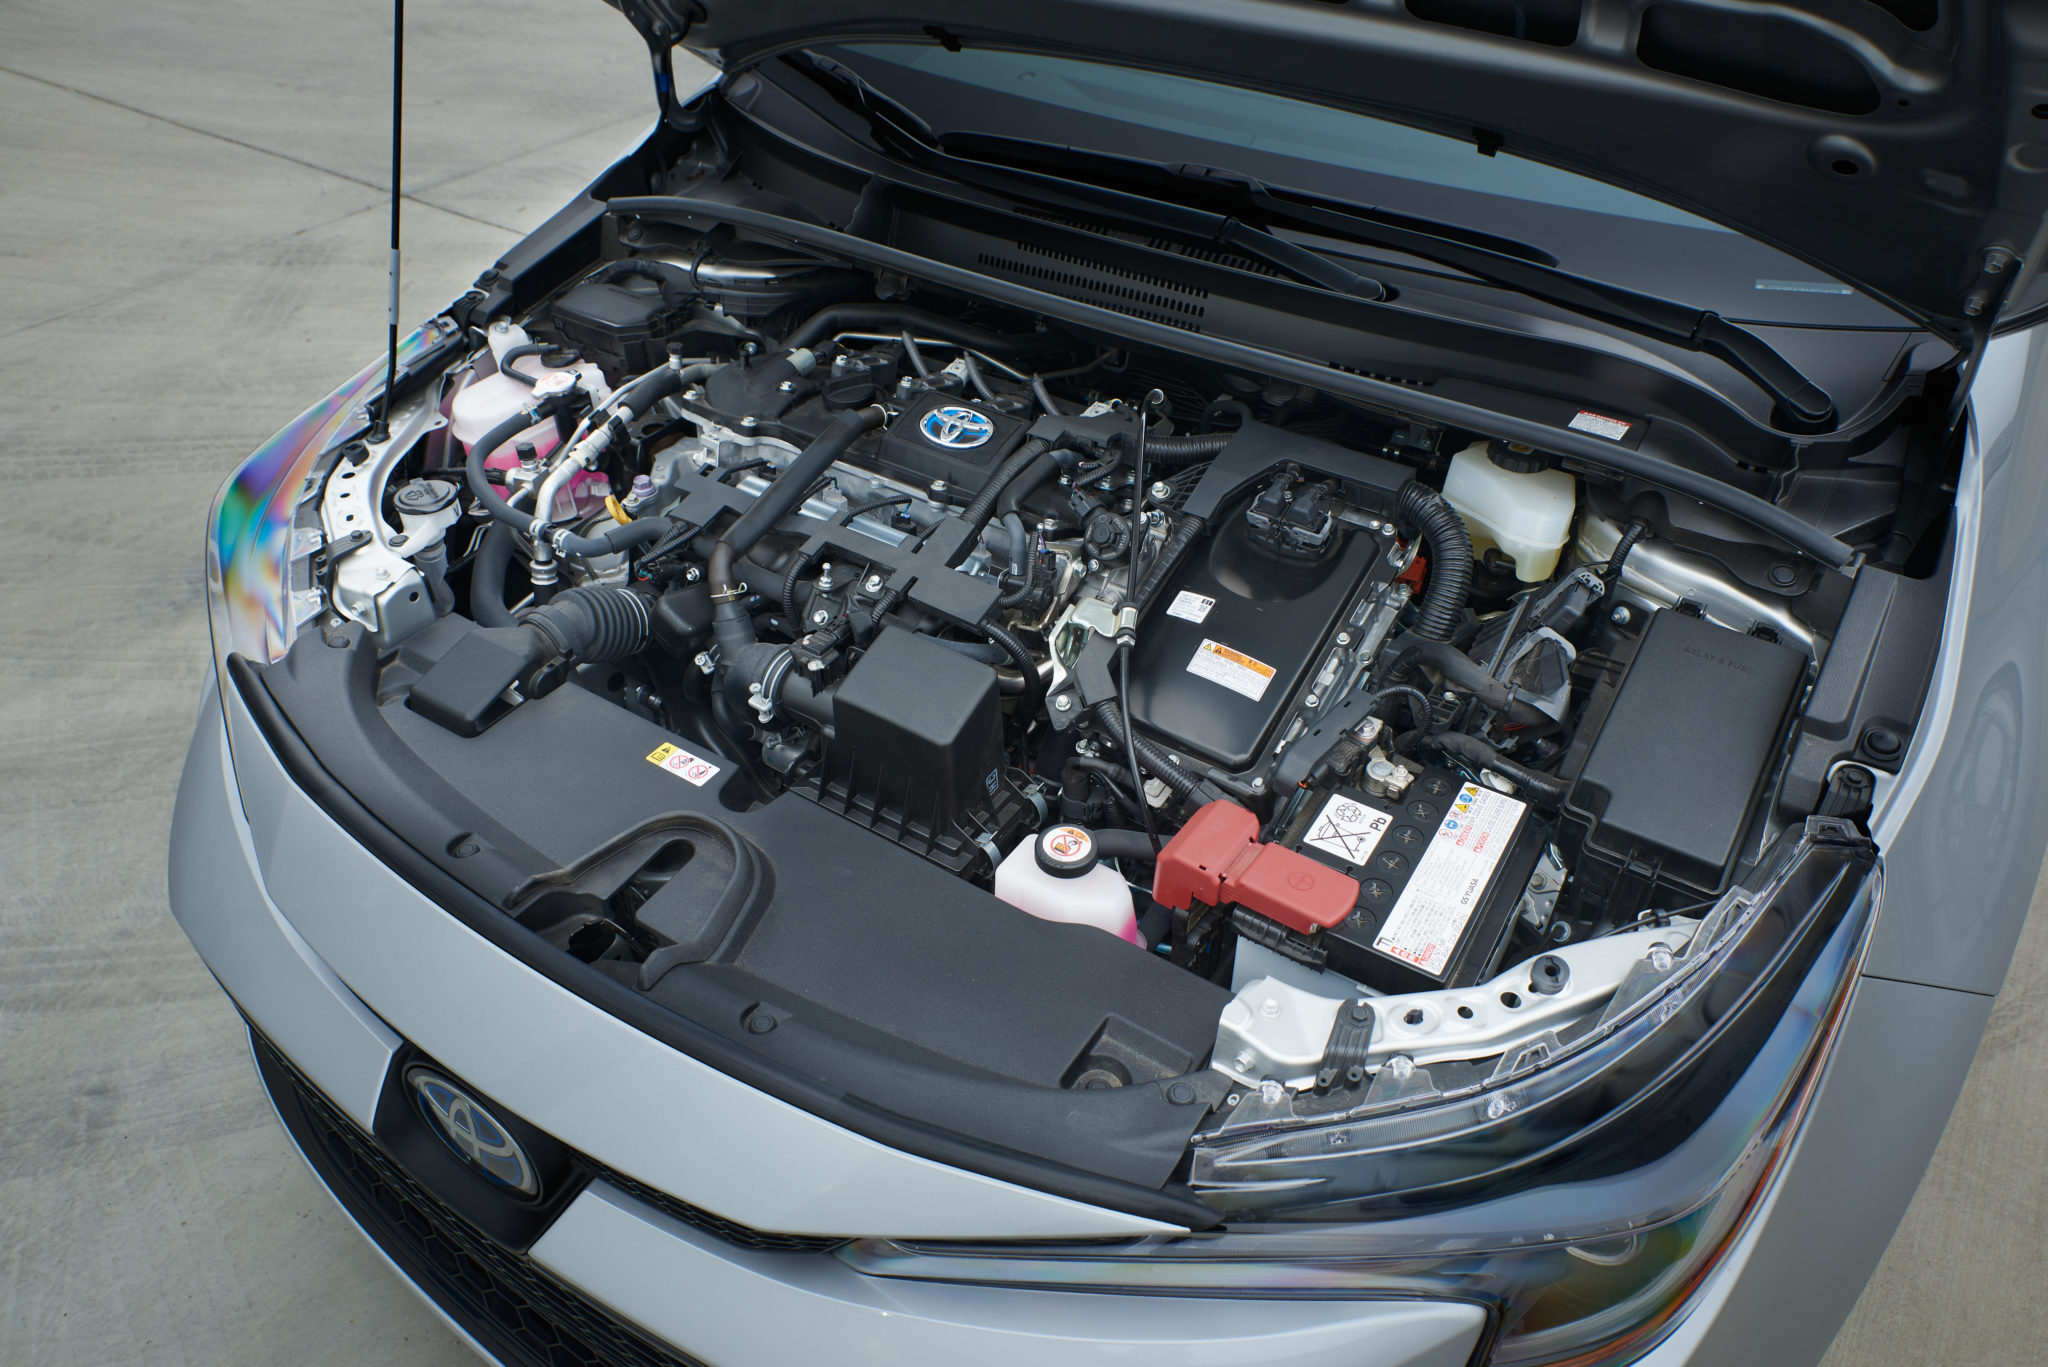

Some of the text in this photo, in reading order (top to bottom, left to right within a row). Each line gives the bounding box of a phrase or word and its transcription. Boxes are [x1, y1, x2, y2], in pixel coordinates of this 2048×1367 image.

[1369, 816, 1387, 832] Pb
[1464, 877, 1479, 896] YUASA
[1460, 893, 1469, 905] GS
